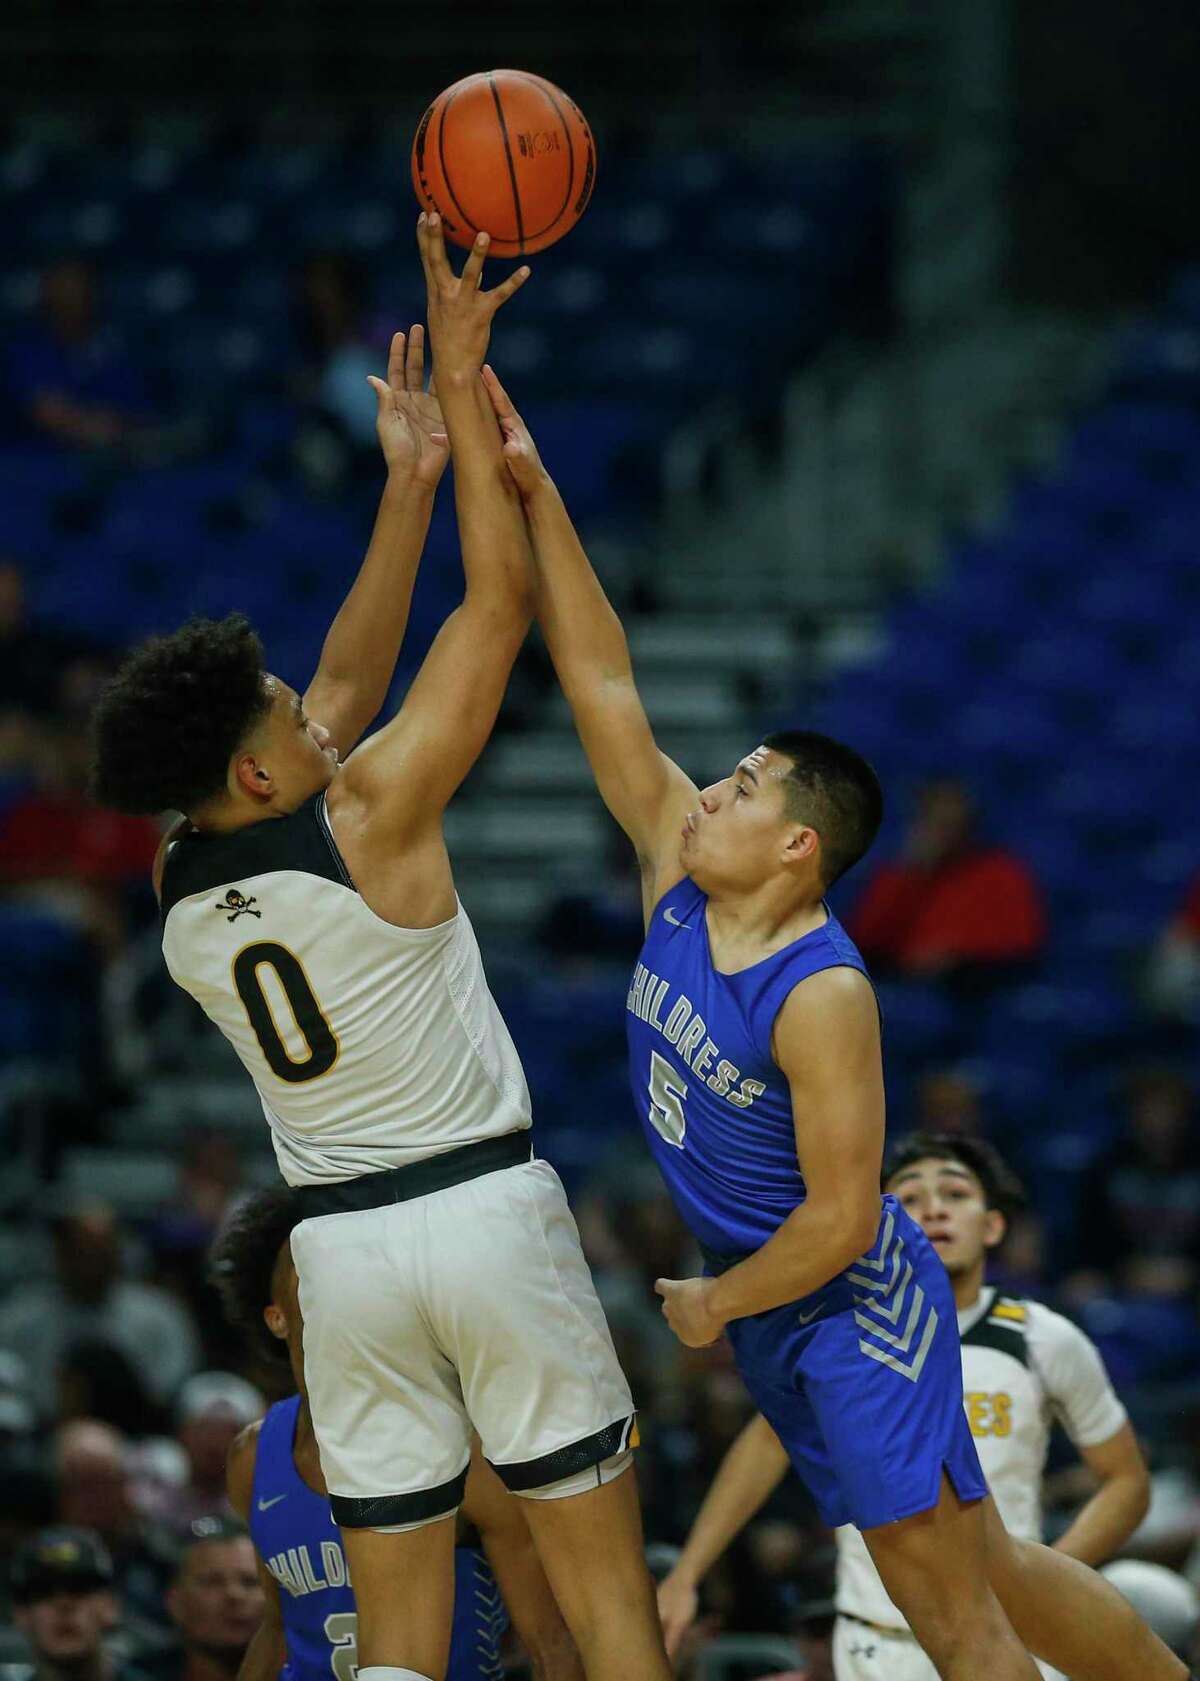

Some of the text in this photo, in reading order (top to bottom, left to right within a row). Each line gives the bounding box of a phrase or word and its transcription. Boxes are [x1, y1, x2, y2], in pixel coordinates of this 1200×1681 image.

[231, 939, 341, 1086] 0
[648, 1049, 689, 1150] 5
[965, 1391, 1012, 1438] ES
[265, 1541, 352, 1598] HILD
